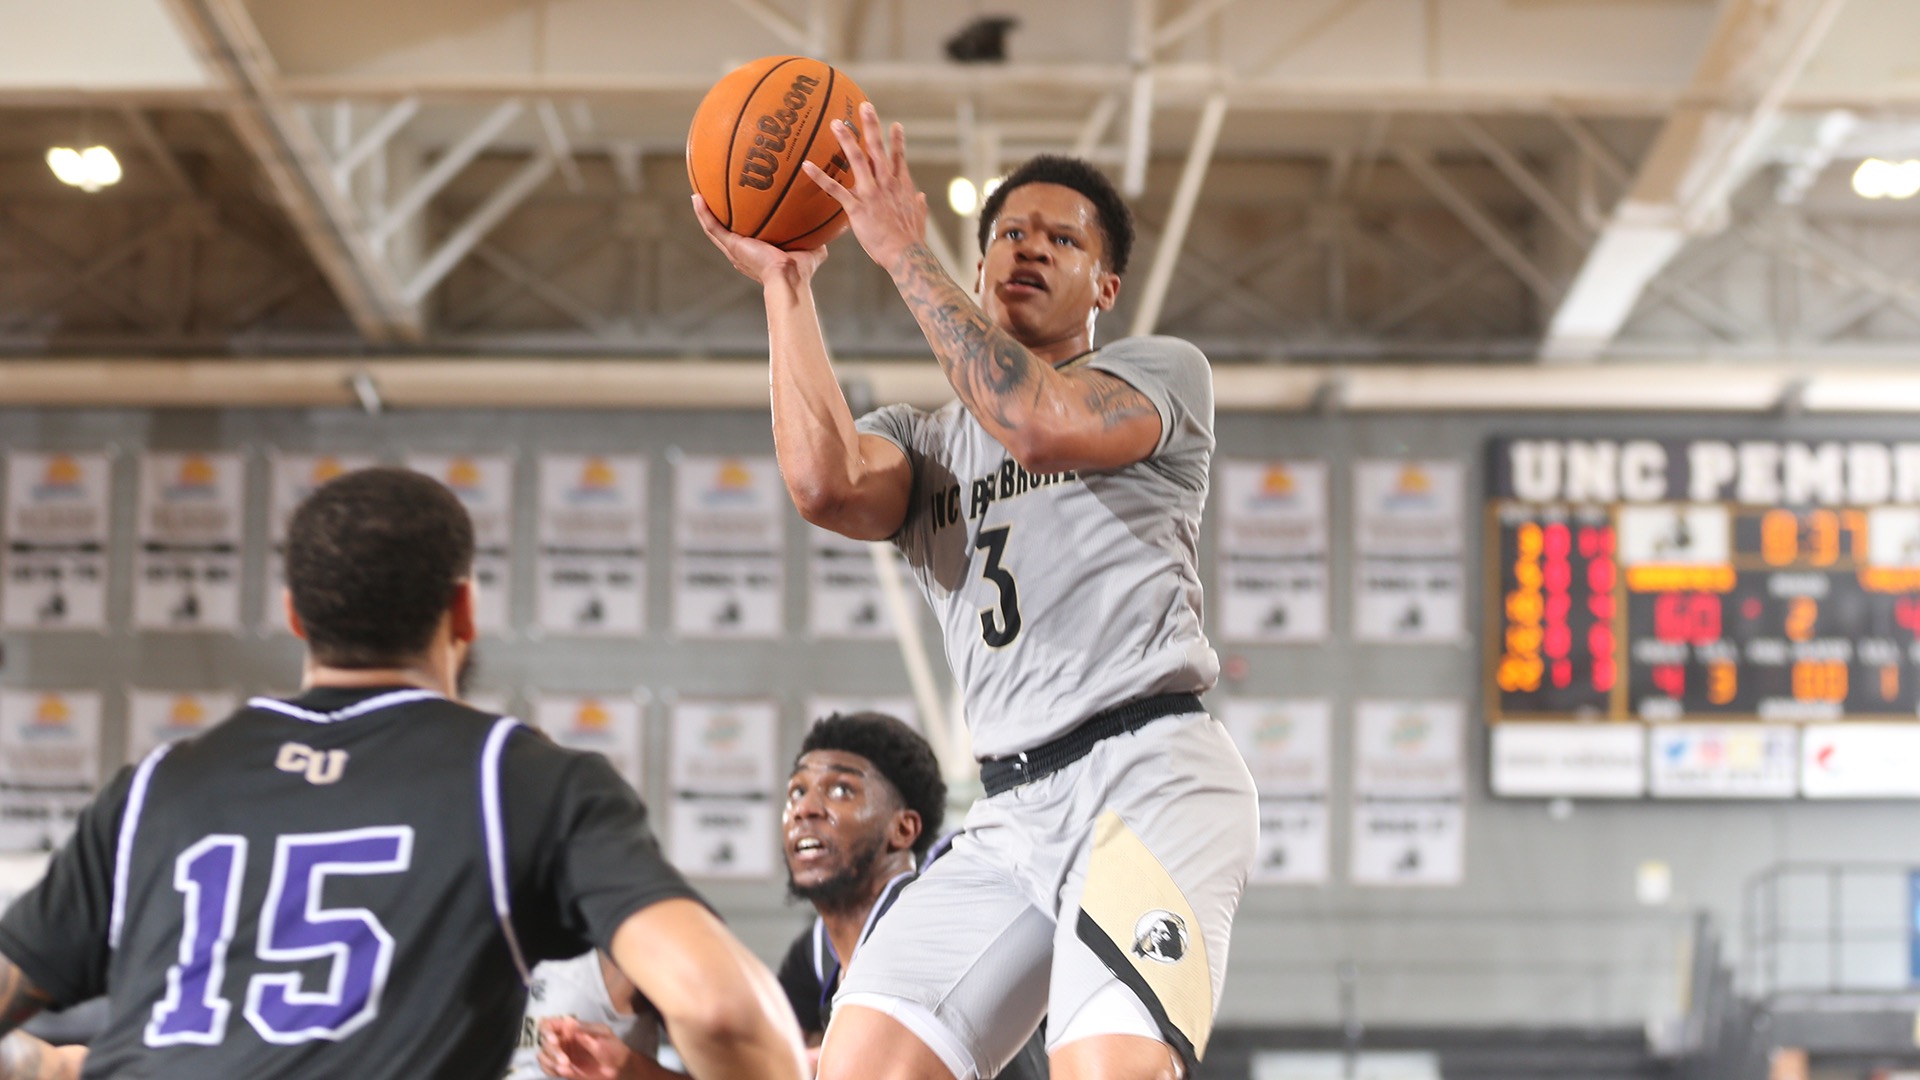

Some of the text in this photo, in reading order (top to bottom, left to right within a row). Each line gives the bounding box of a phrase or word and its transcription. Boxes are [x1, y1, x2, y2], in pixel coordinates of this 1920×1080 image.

[738, 74, 820, 191] Wilson
[1511, 440, 1668, 502] UNC
[975, 523, 1022, 649] 3
[275, 742, 348, 785] CU
[144, 825, 413, 1047] 15
